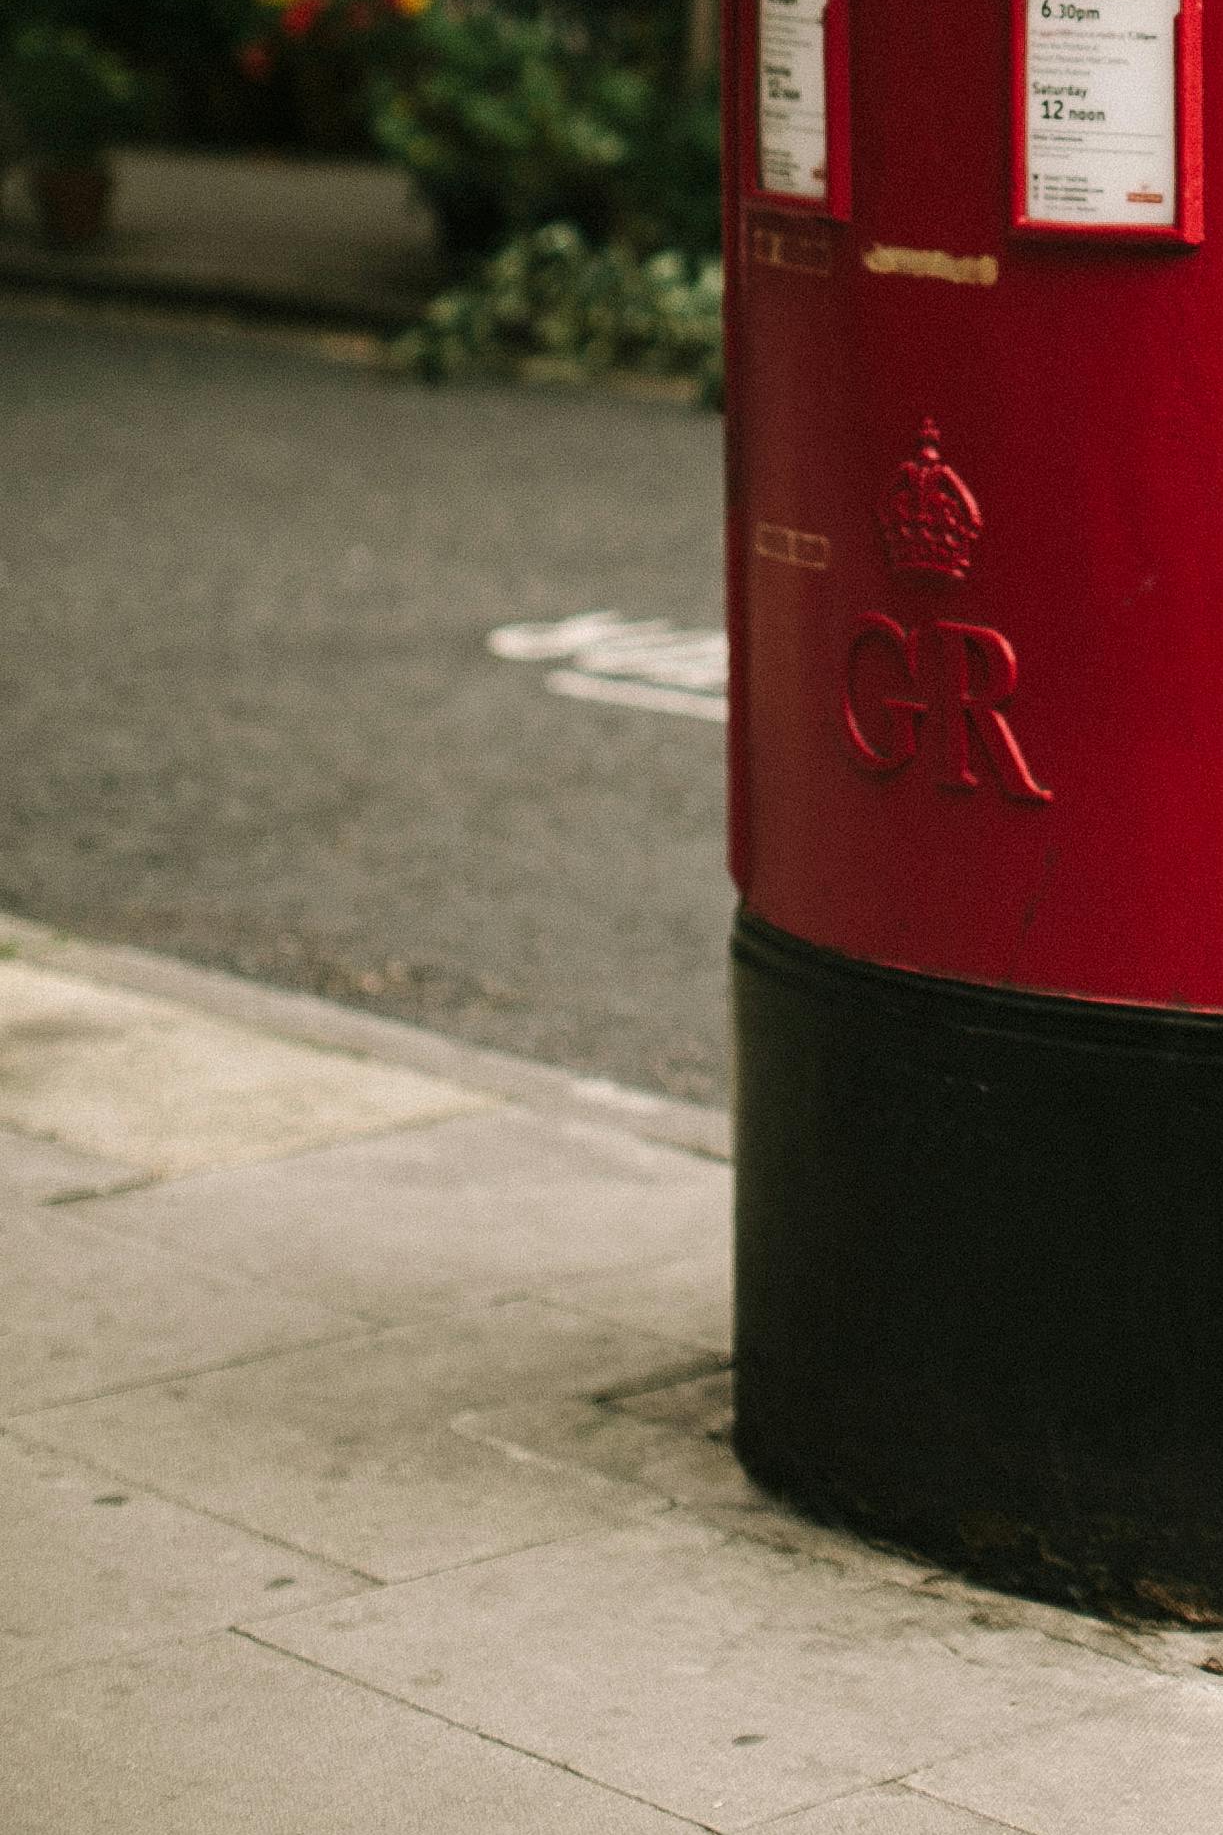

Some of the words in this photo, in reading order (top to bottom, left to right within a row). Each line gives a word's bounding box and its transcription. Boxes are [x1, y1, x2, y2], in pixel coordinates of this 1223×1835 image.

[1032, 82, 1088, 99] Saturday
[1040, 100, 1064, 121] 12
[1068, 107, 1106, 122] noon
[842, 610, 1056, 807] GR
